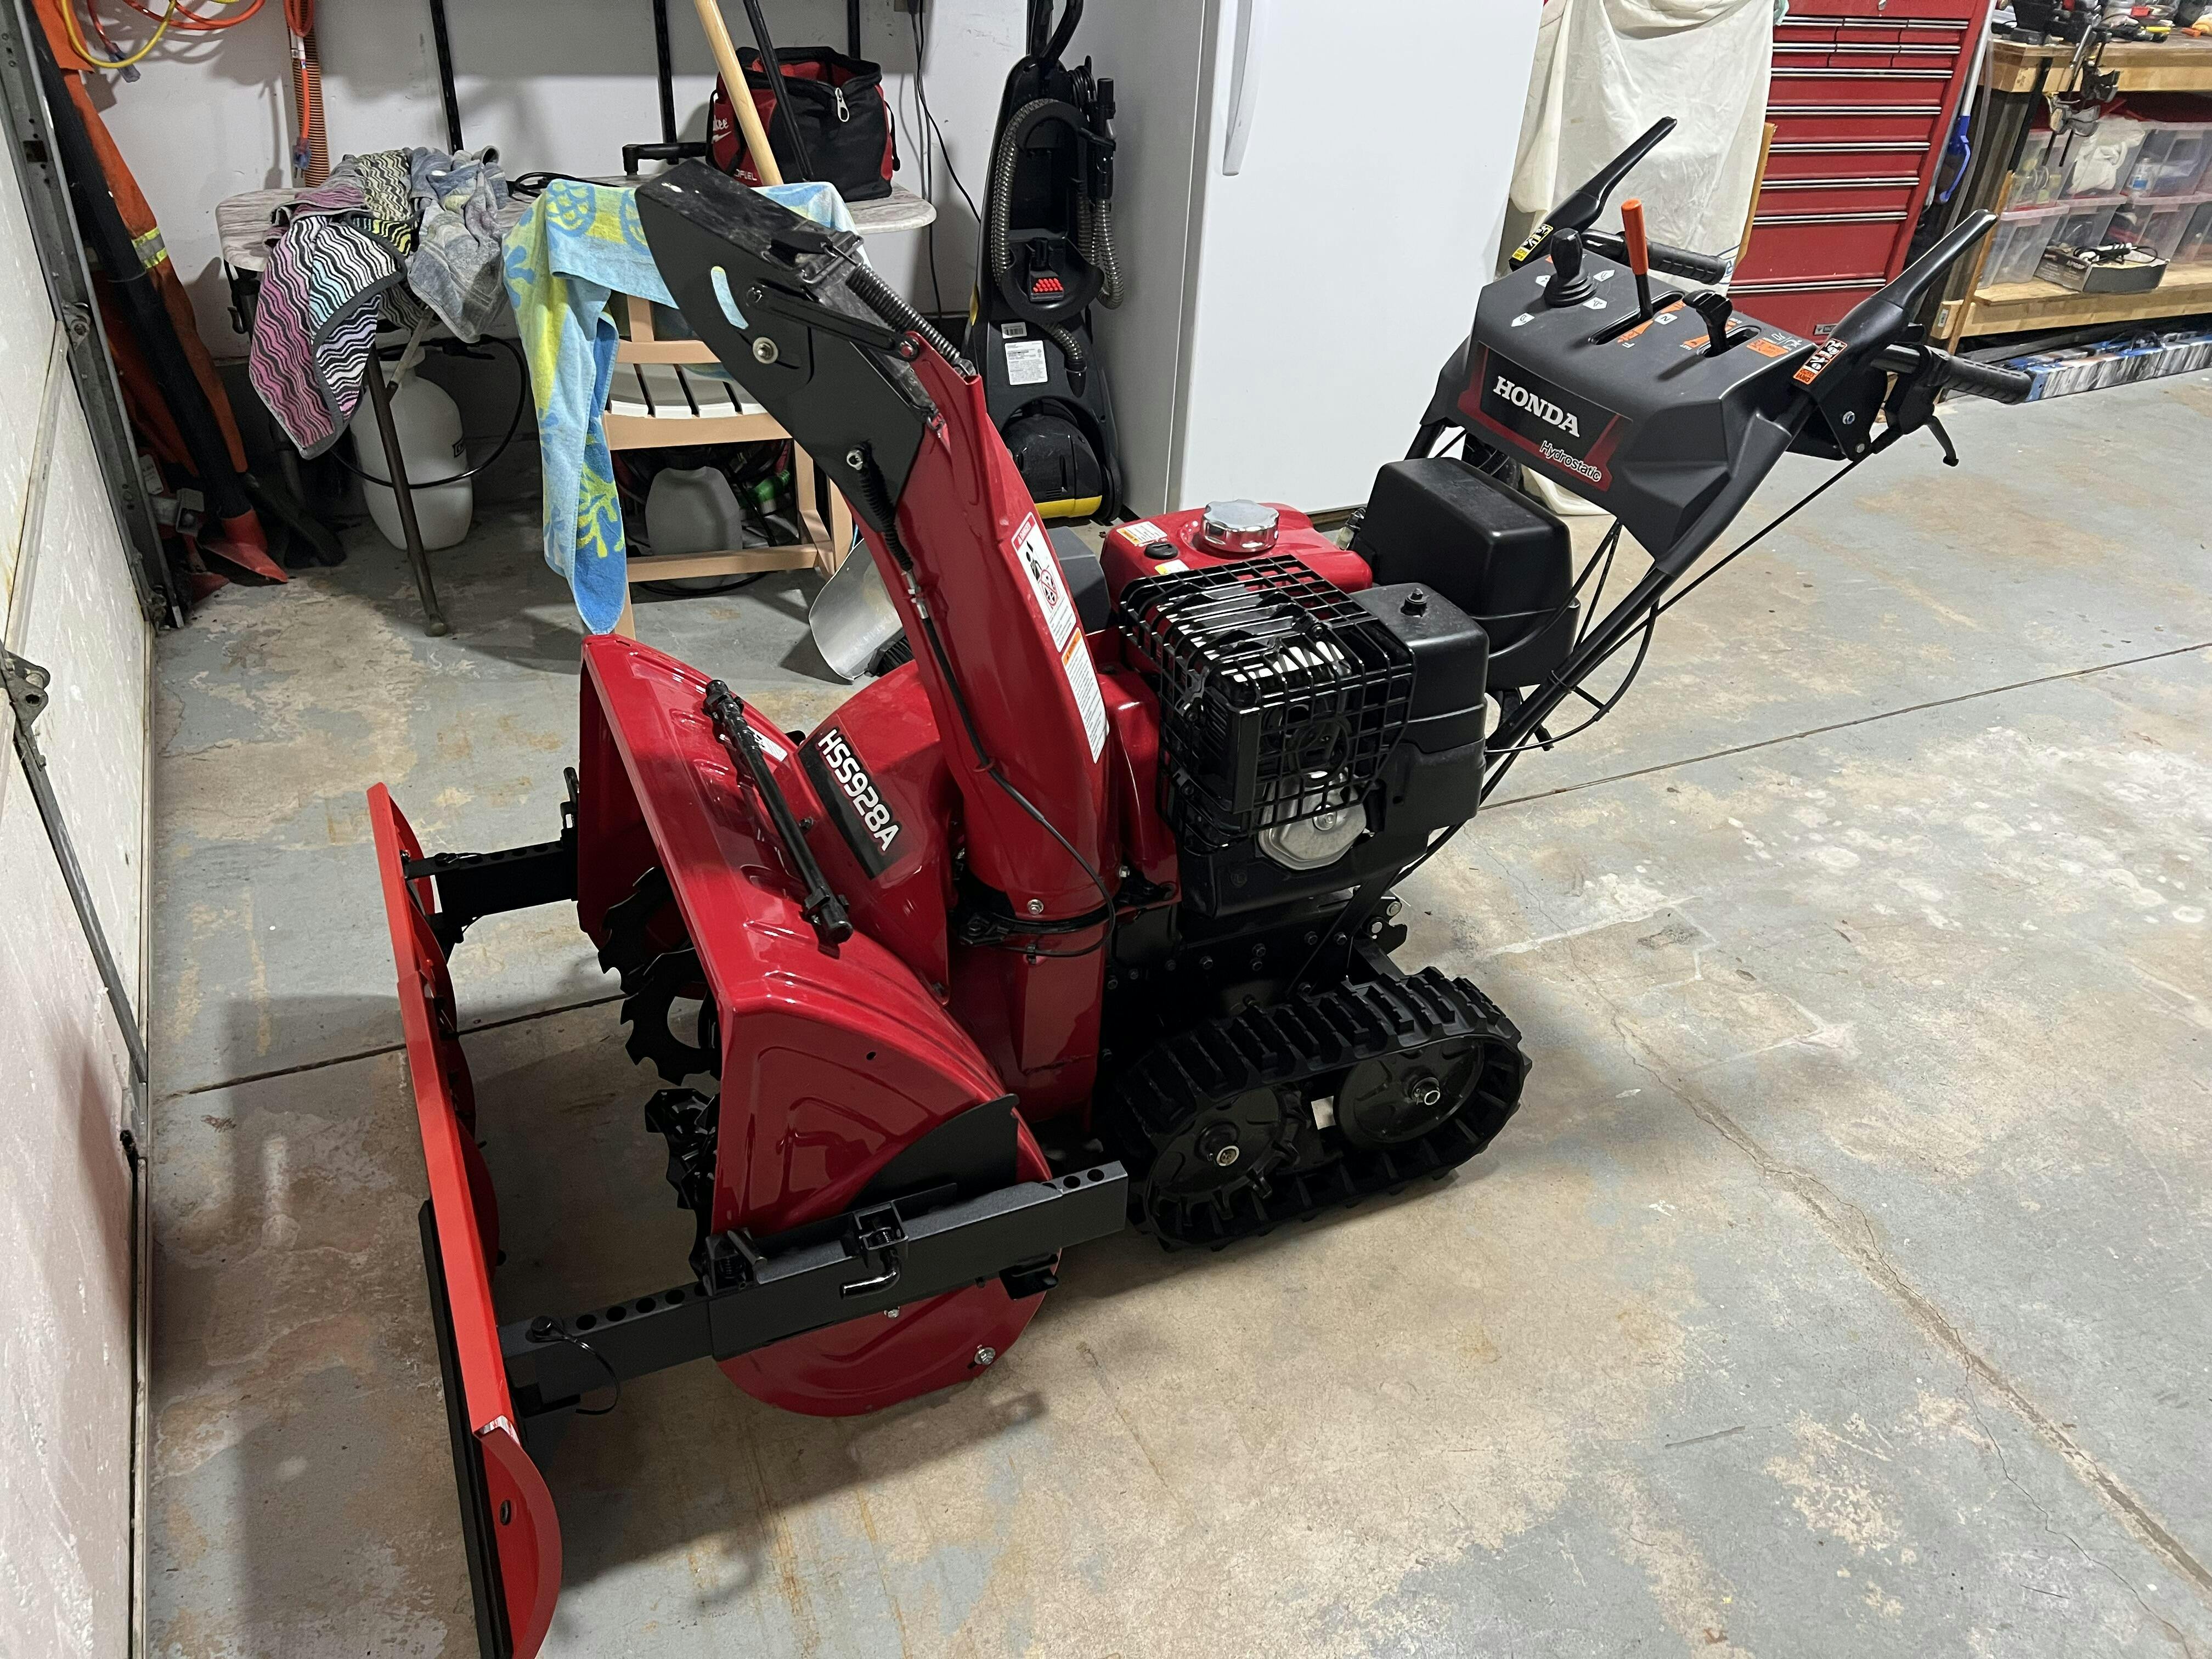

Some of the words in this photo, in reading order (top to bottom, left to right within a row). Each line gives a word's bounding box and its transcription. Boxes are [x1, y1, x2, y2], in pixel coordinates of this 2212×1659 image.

[1493, 376, 1580, 438] HONDA
[1539, 441, 1602, 482] Hydrostatic
[818, 729, 899, 851] HSS928A
